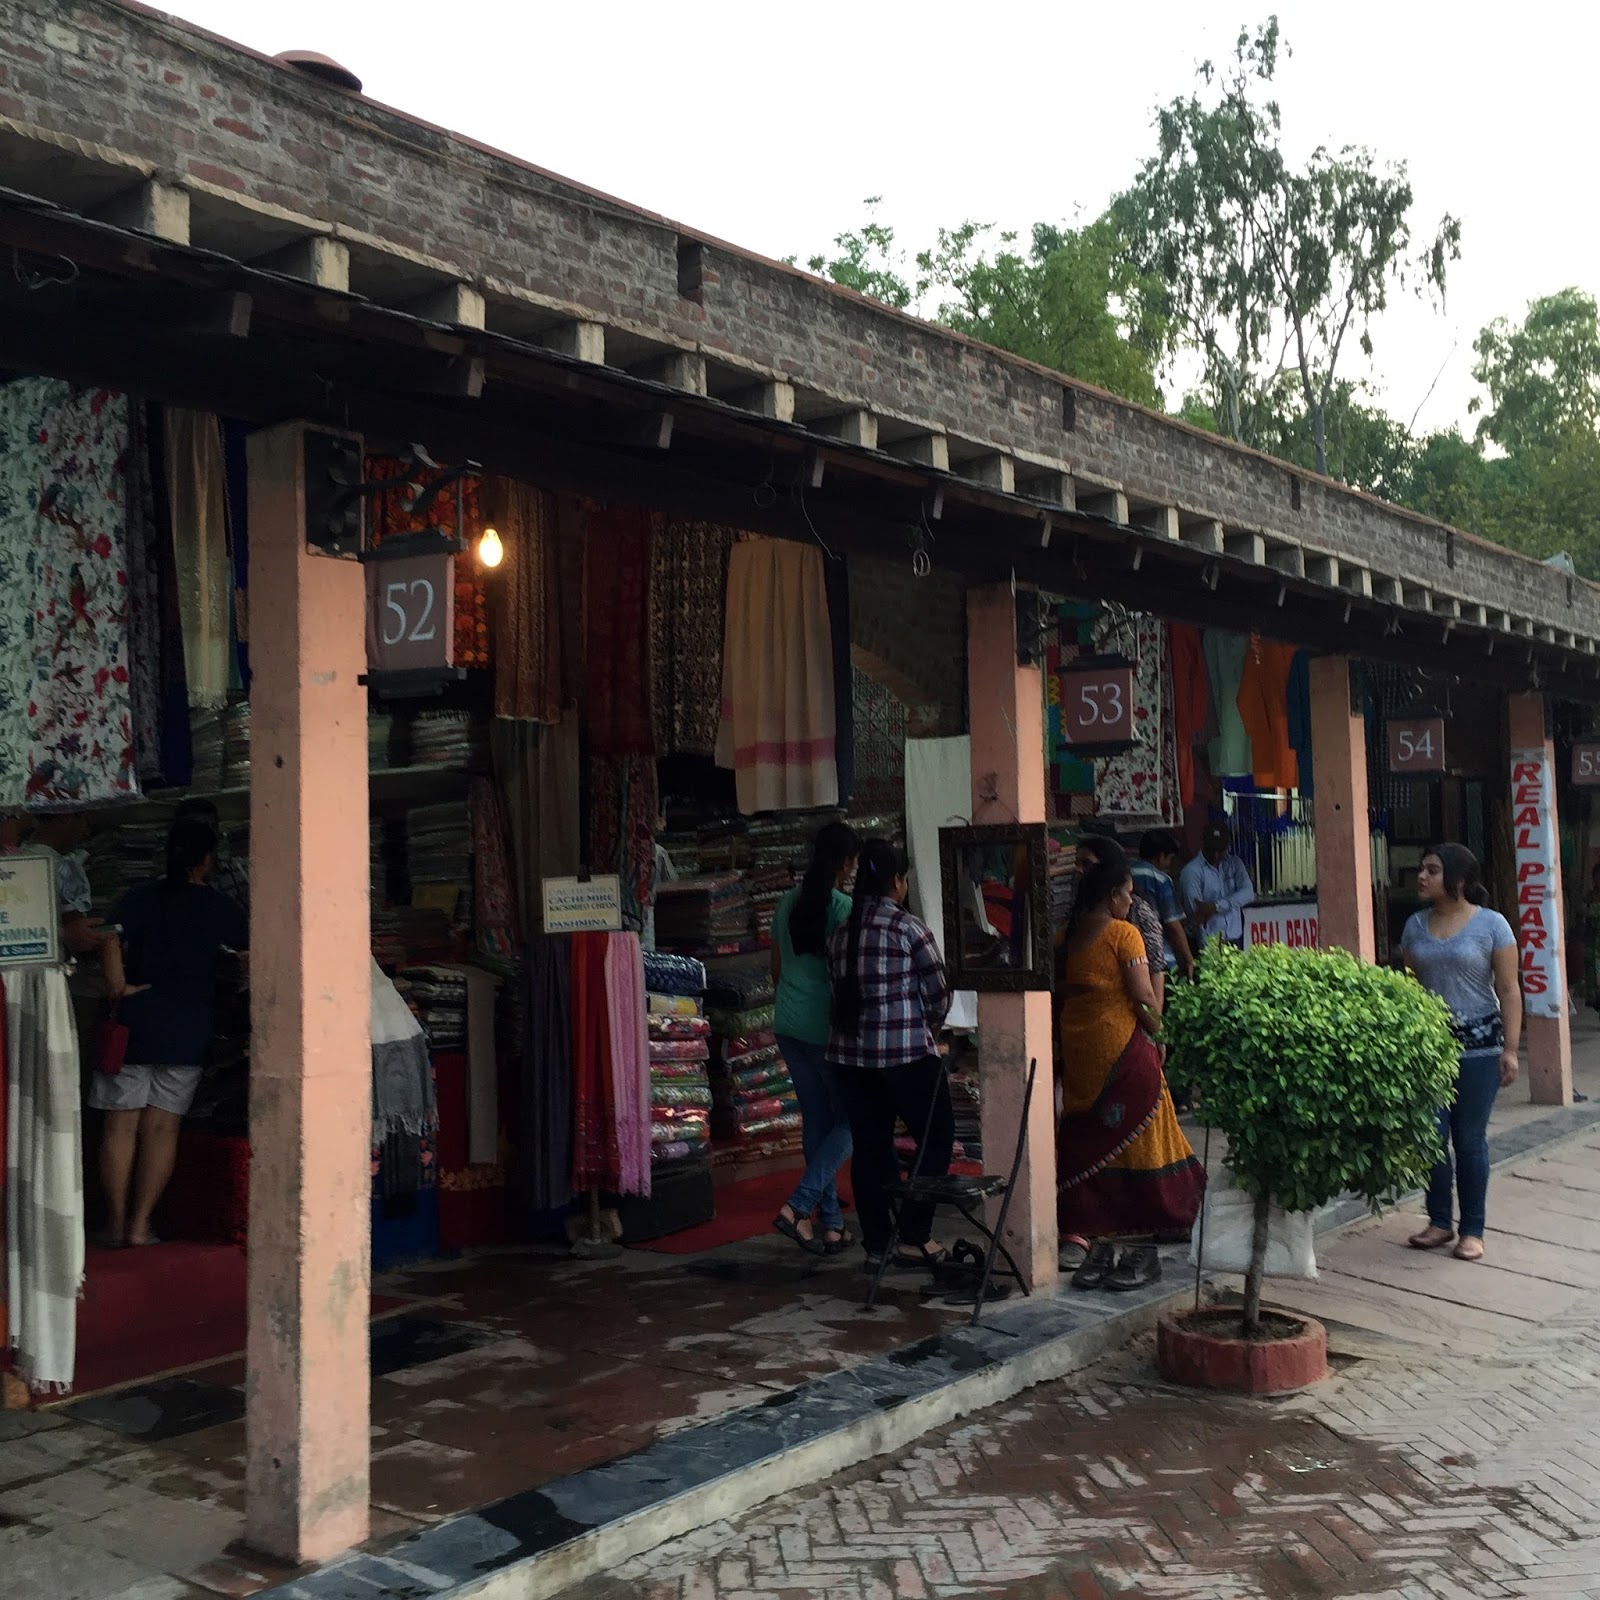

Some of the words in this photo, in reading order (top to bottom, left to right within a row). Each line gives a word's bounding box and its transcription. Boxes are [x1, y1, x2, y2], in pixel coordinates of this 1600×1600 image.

[383, 579, 436, 645] 52
[1078, 682, 1123, 726] 53
[1397, 729, 1435, 762] 54
[1513, 762, 1542, 849] REAL
[549, 919, 608, 929] PASHMINA
[1517, 862, 1549, 995] PEARLS
